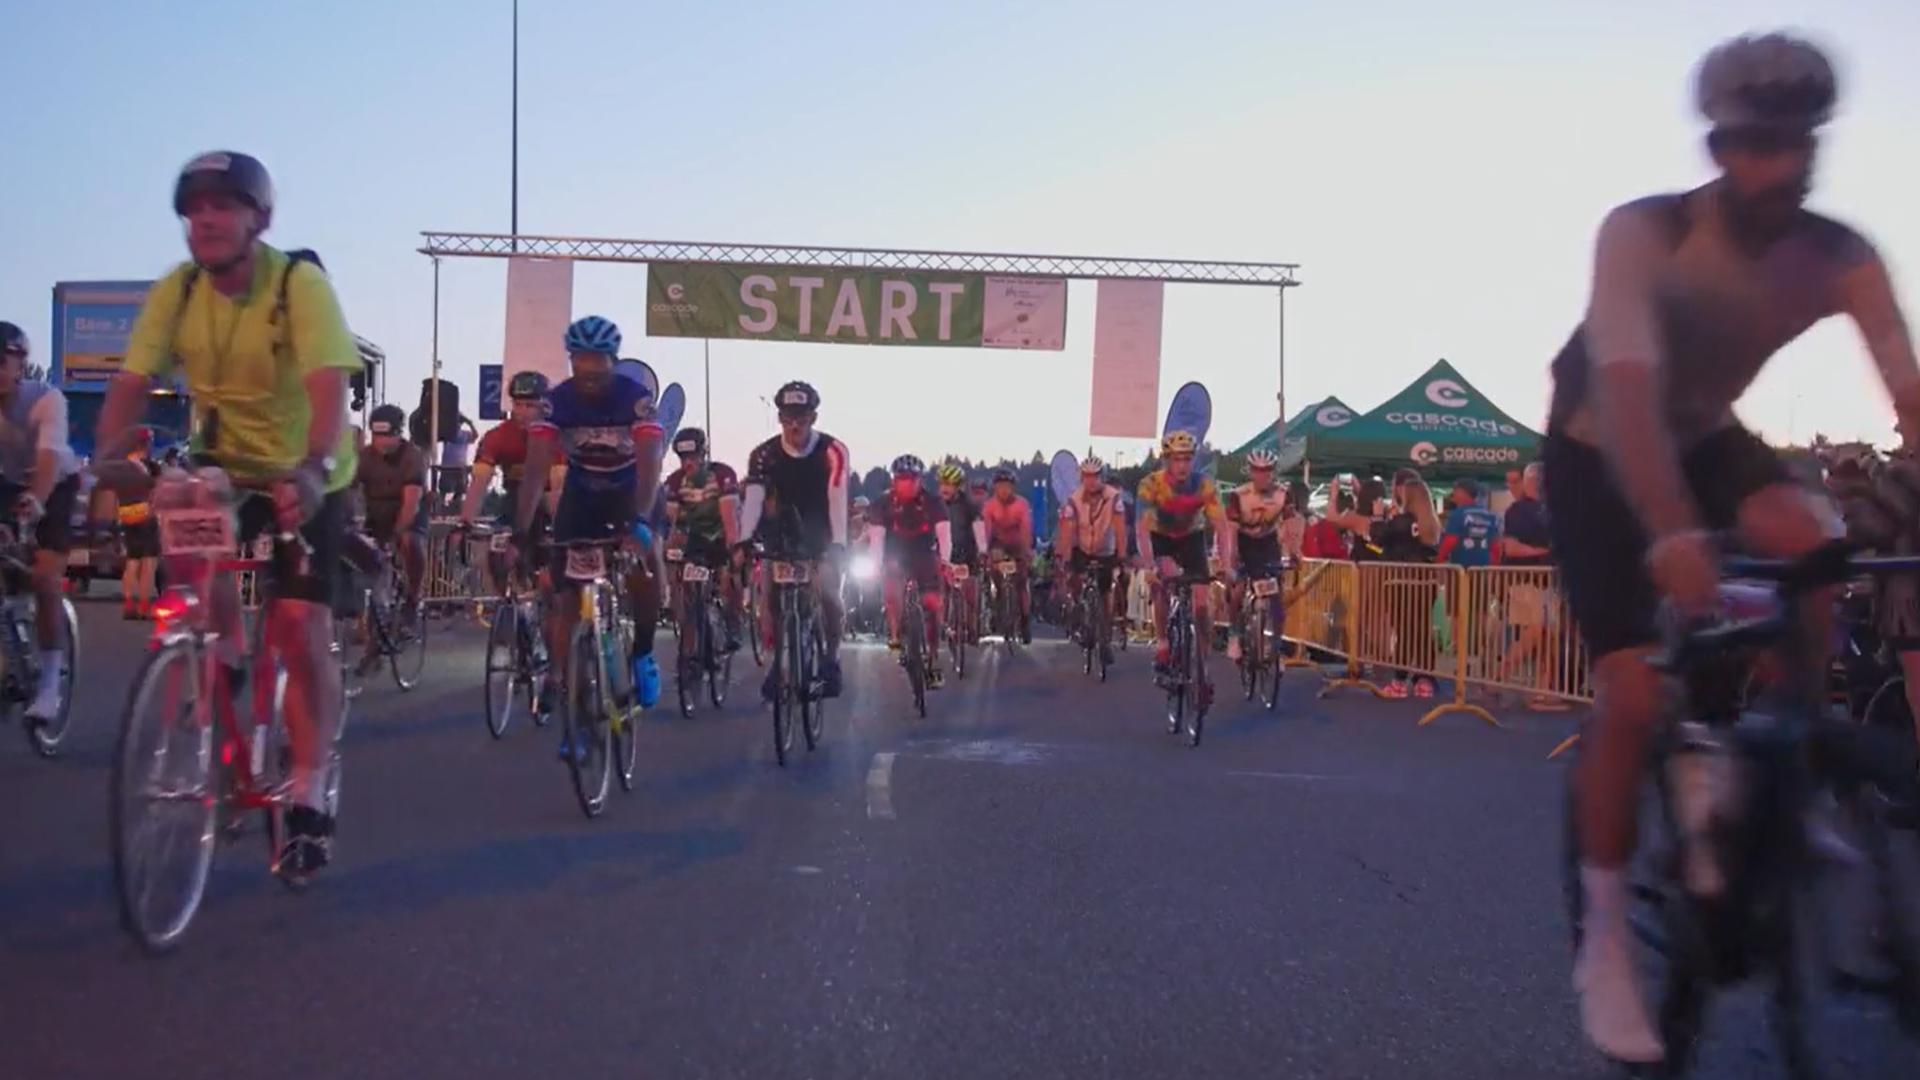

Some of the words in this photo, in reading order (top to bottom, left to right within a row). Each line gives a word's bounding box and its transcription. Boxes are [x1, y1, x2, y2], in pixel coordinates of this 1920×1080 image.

[738, 274, 965, 341] START
[484, 380, 501, 403] 2
[1385, 412, 1518, 435] cascade
[1443, 446, 1519, 462] cascade
